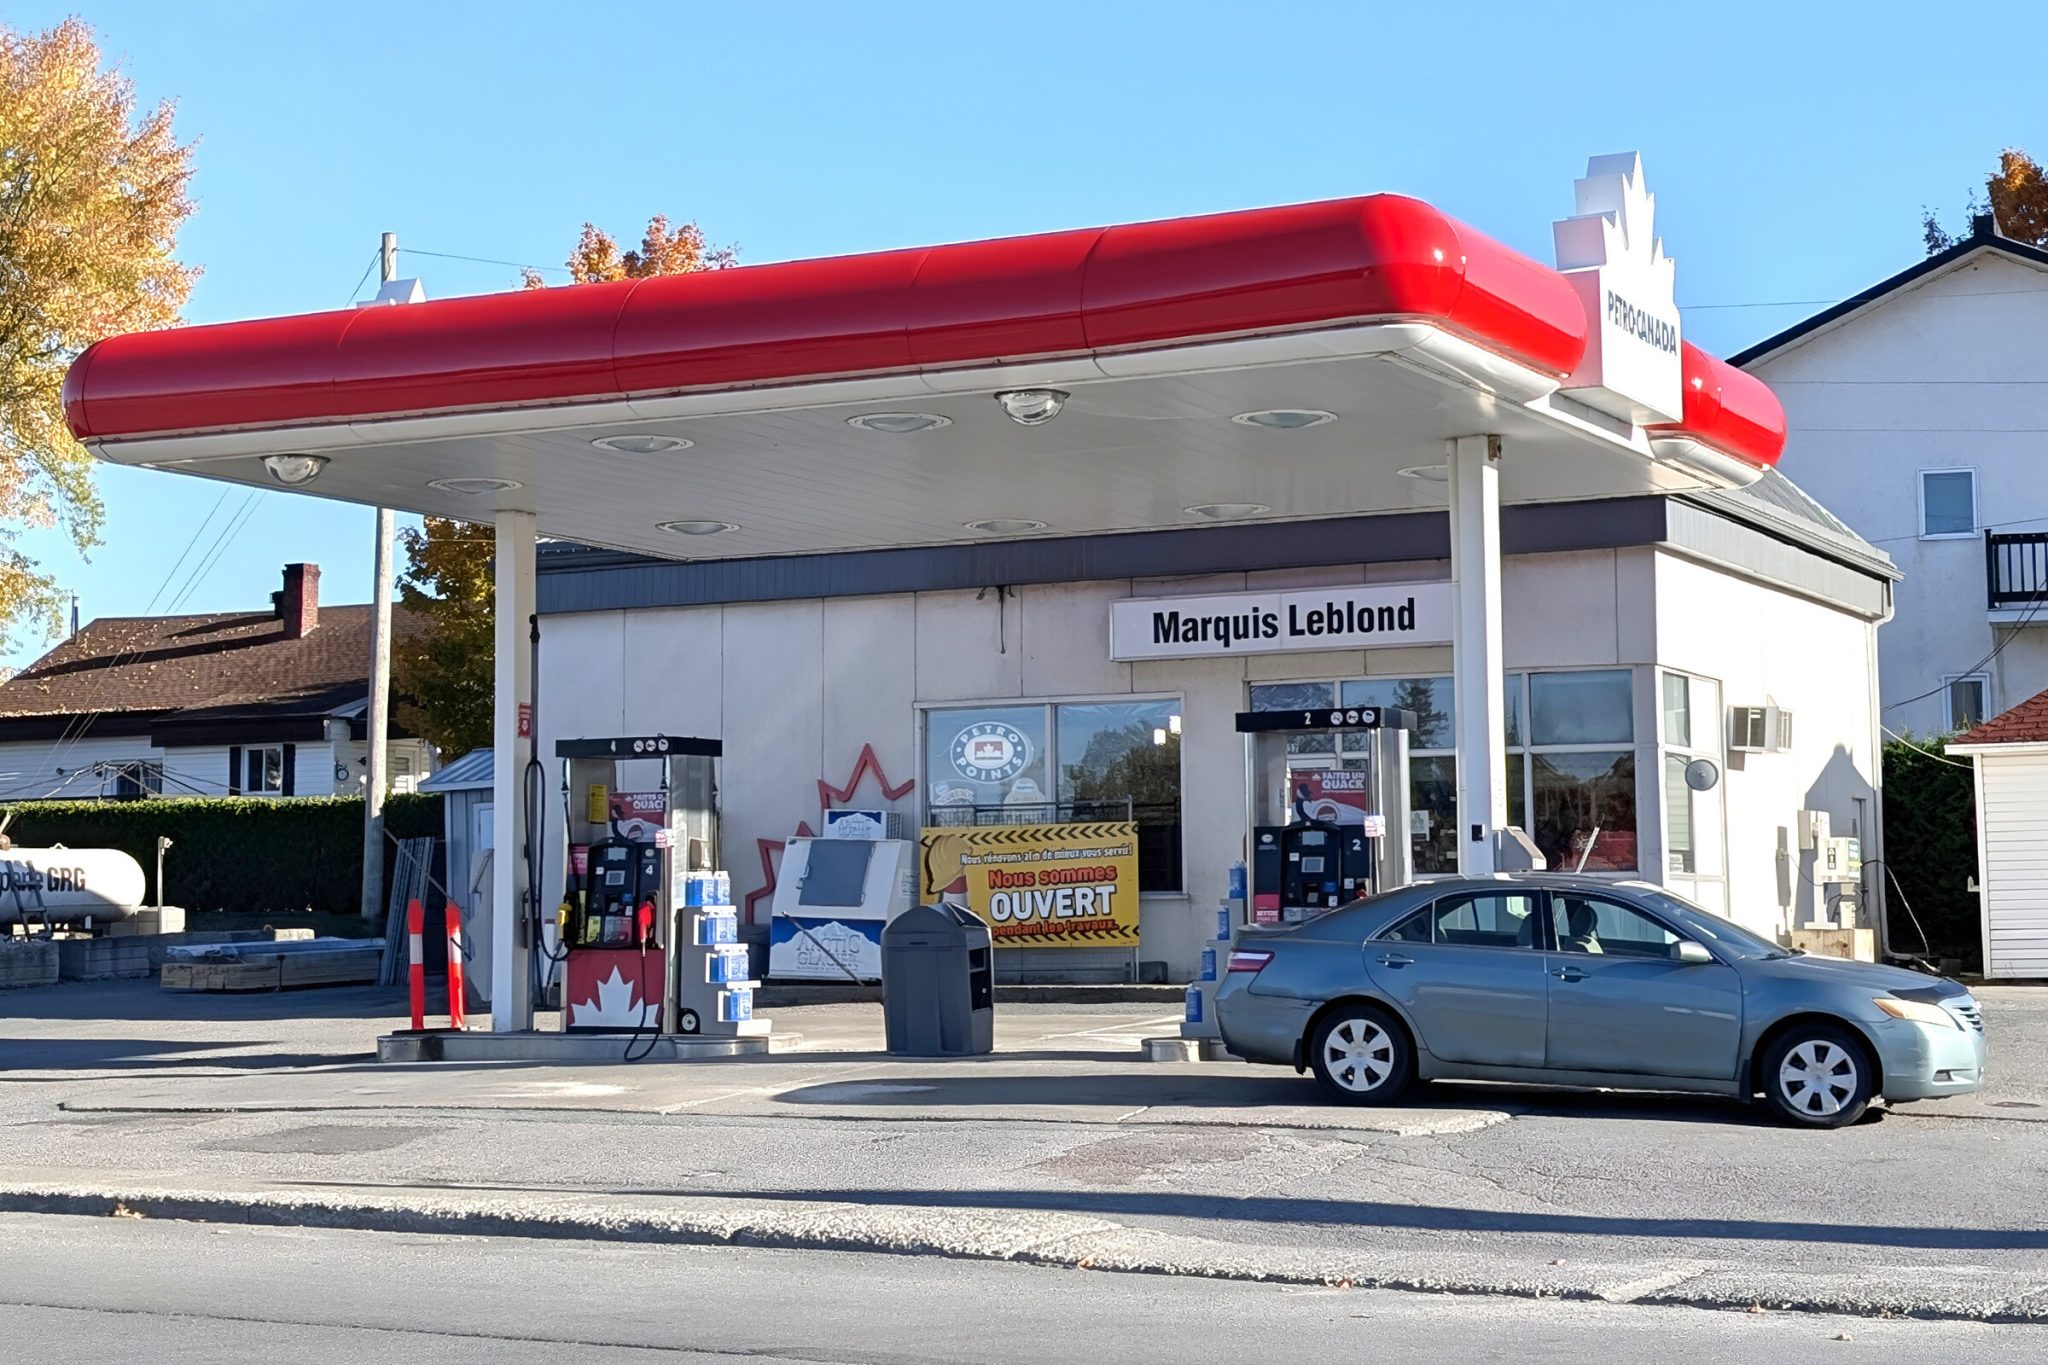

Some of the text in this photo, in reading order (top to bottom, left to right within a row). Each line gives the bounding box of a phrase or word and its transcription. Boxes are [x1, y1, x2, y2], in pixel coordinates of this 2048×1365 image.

[1608, 290, 1677, 356] PETRO-CANADA
[1153, 598, 1415, 648] Marquis Leblond
[1304, 712, 1312, 725] 2
[959, 725, 1020, 744] PETRO
[610, 740, 617, 752] 4
[956, 756, 1023, 781] POINTS
[1321, 780, 1364, 789] QUACK
[1352, 838, 1362, 851] 2
[961, 853, 982, 865] Nous
[645, 864, 654, 876] 4
[988, 866, 1118, 889] Nous sommes
[47, 867, 85, 892] GRG
[990, 884, 1117, 921] OUVERT
[992, 922, 1043, 937] pendant
[1044, 921, 1065, 934] les
